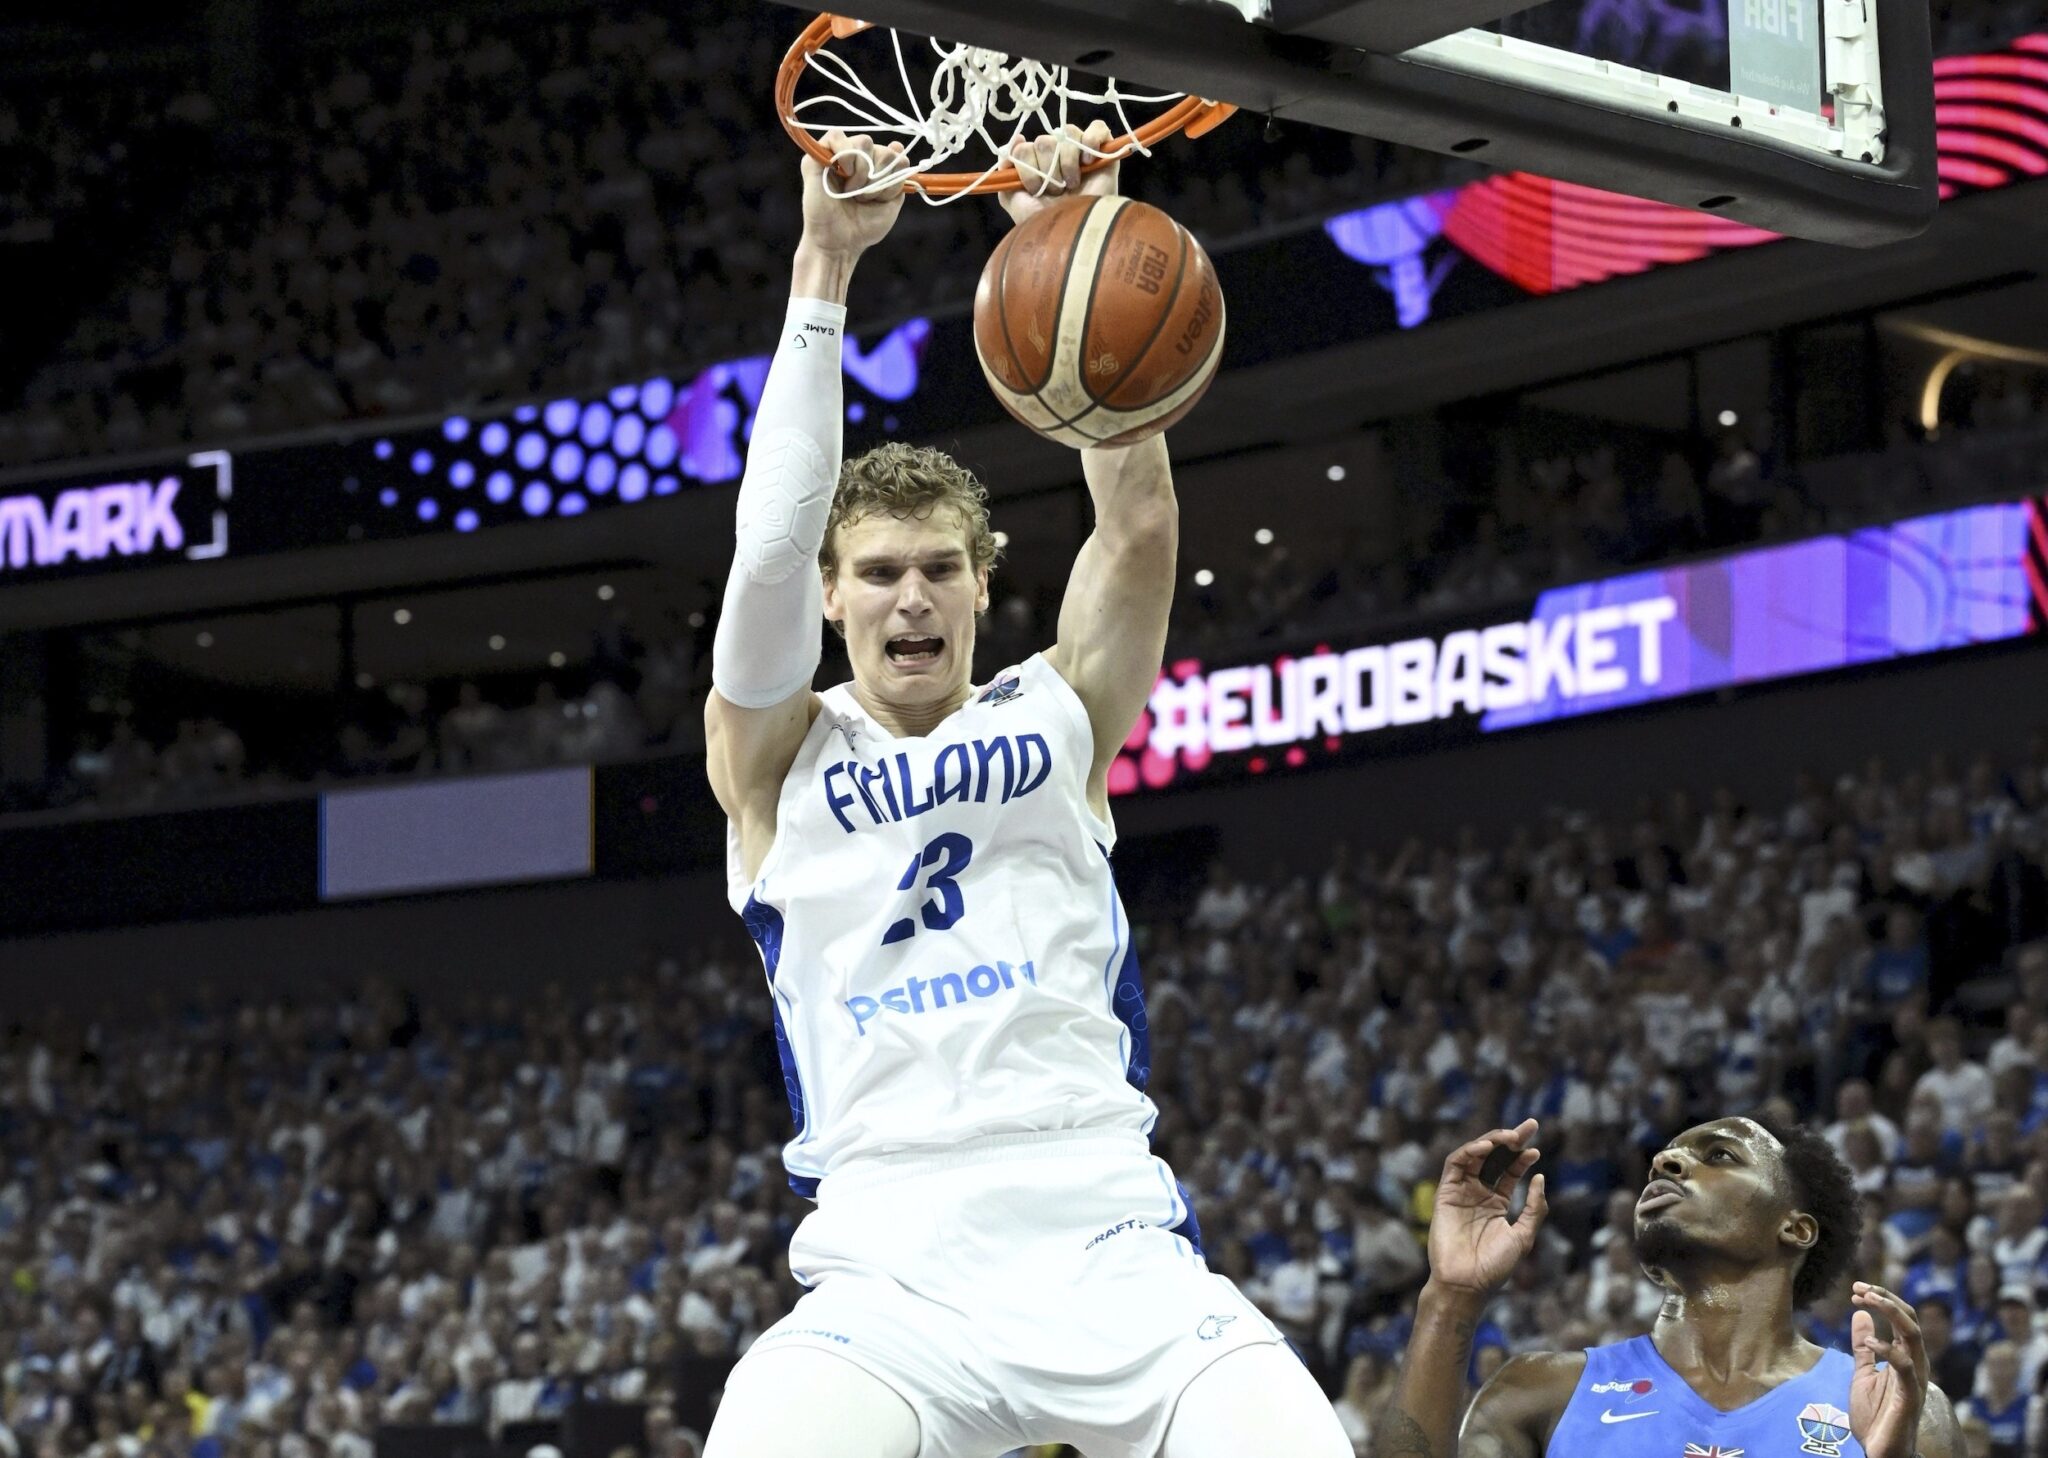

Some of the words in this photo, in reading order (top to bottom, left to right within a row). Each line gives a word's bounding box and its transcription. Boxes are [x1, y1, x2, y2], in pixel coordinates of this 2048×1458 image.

[1136, 244, 1169, 295] FIBA
[803, 323, 835, 336] GAME
[1148, 595, 1676, 758] #EUROBASKET
[823, 733, 1052, 834] FINLAND
[1085, 1219, 1136, 1250] CRAFT
[1803, 1440, 1839, 1456] 25
